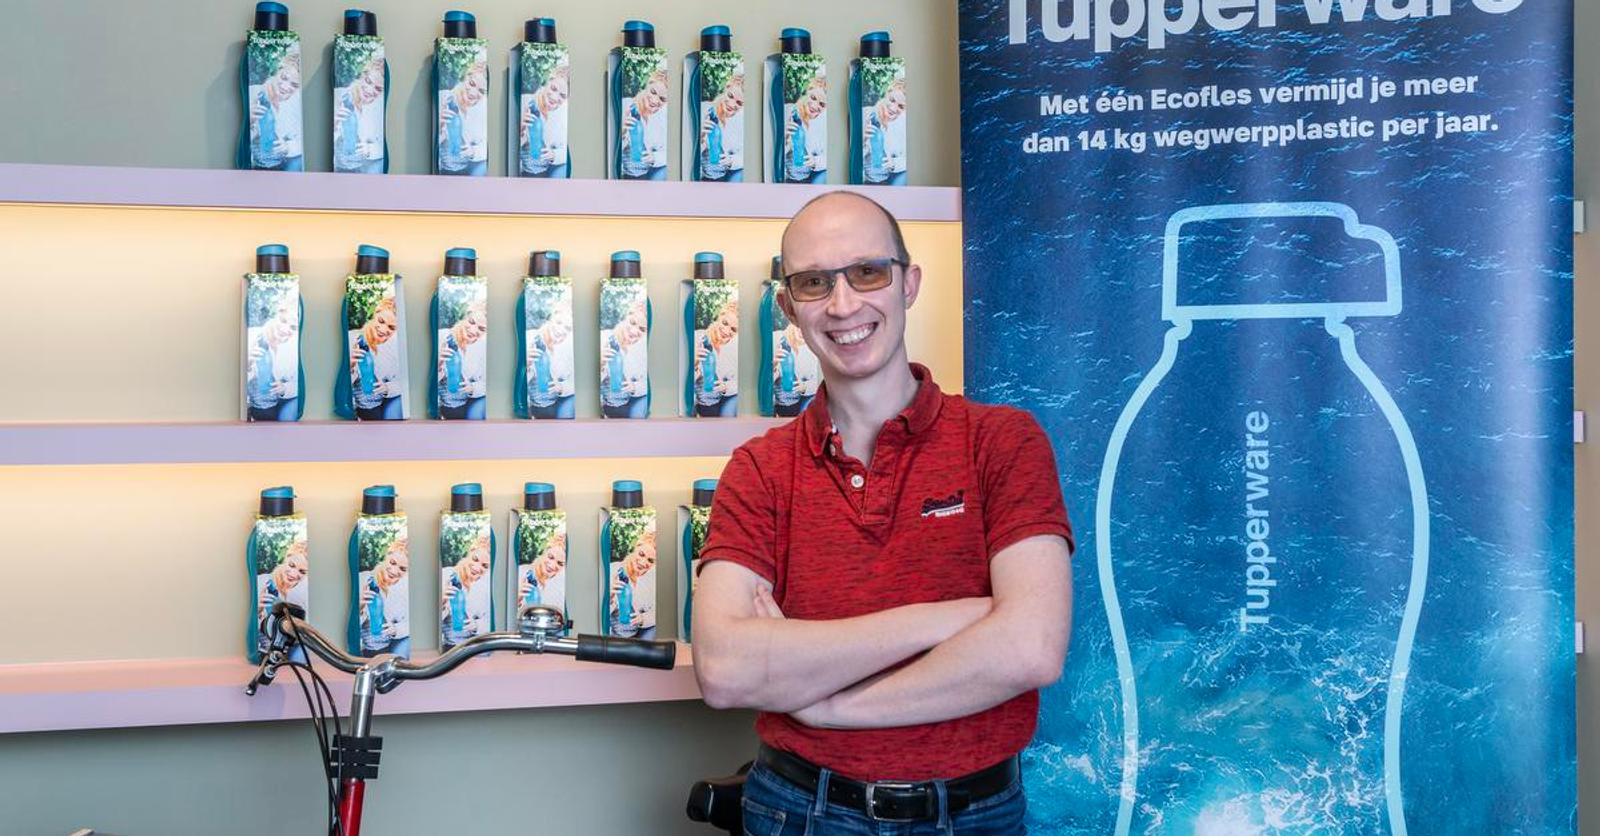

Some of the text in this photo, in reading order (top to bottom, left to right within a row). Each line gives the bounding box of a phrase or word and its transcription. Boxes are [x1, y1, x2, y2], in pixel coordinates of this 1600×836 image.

[1007, 0, 1524, 53] Tupper
[1040, 75, 1478, 116] Met één Ecofles vermijd je meer
[1022, 112, 1499, 154] dan 14 kg wegwerpplastic per jaar.
[1239, 410, 1277, 633] Tupperware
